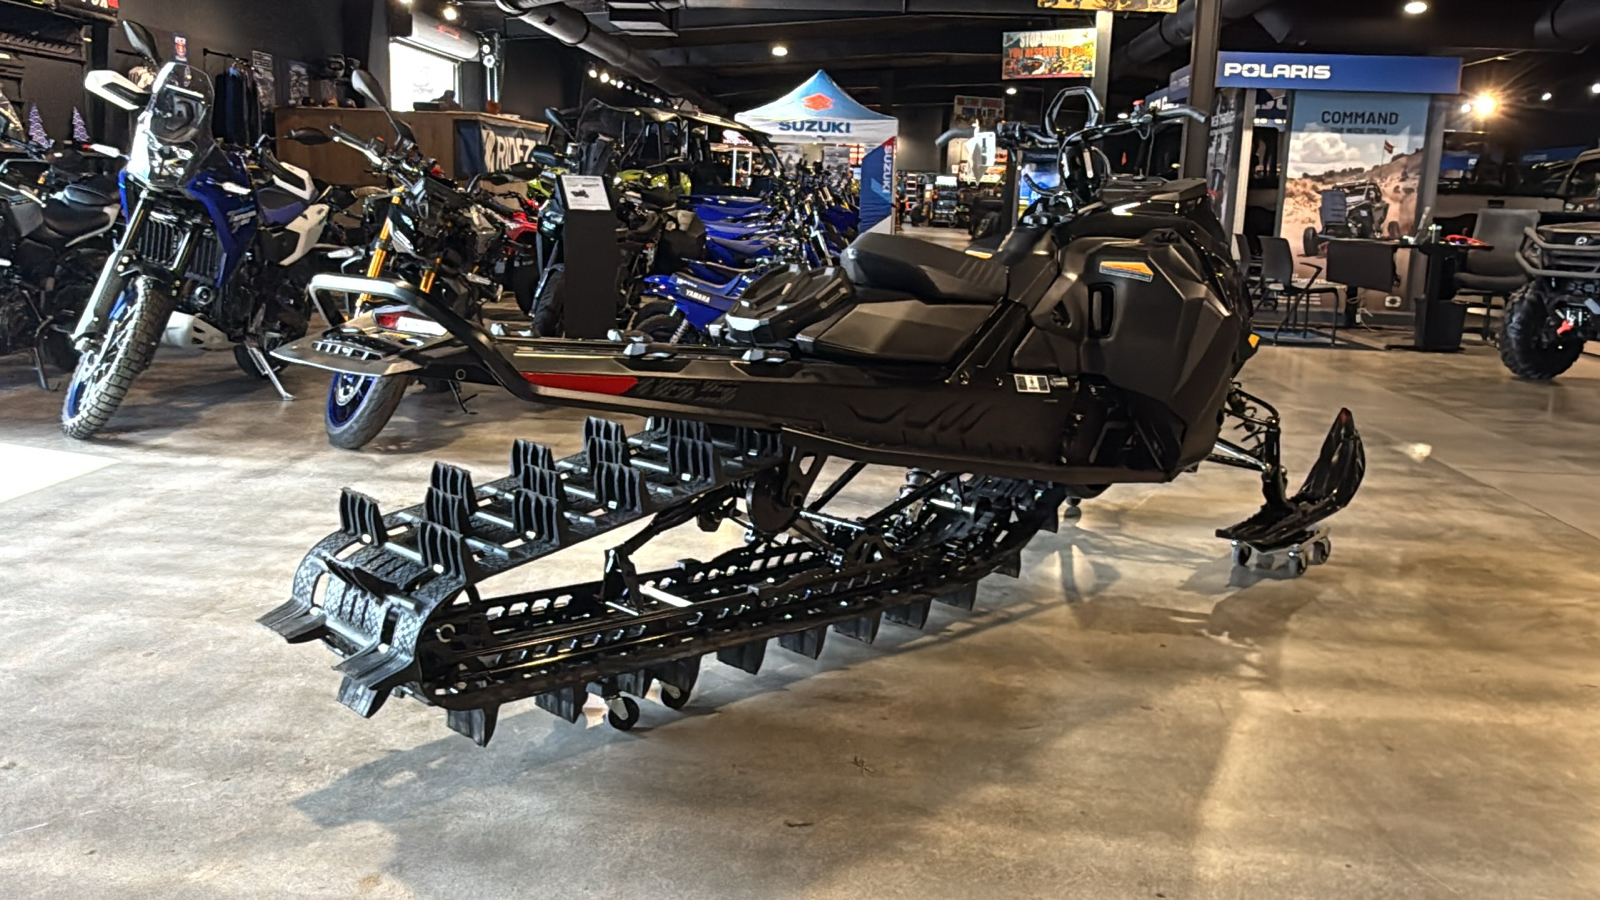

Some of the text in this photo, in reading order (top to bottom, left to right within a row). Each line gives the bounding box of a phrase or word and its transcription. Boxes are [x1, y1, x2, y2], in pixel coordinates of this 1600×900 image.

[1223, 62, 1331, 79] POLARIS
[1321, 110, 1399, 125] COMMAND
[778, 120, 851, 134] SUZUKI
[882, 144, 893, 194] SUZUKI
[685, 289, 711, 304] YAMAHA
